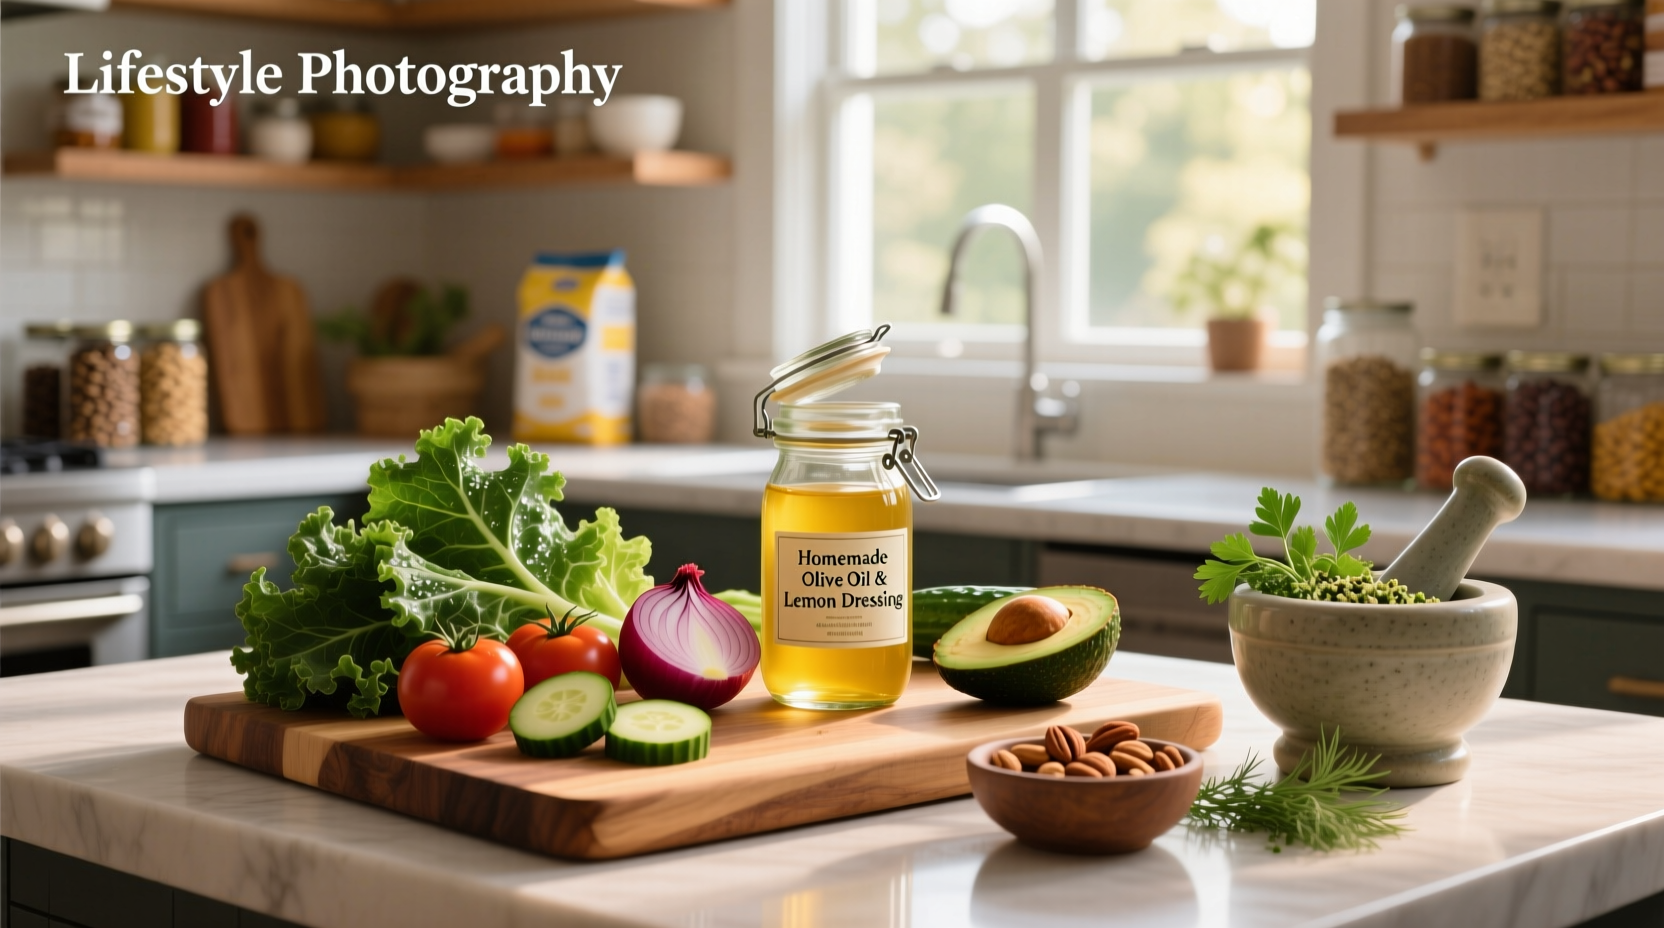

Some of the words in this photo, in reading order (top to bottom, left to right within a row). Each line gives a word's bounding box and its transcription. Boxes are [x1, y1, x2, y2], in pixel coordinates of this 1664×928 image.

[798, 548, 888, 566] Homemade
[801, 571, 843, 588] Olive
[847, 571, 870, 587] Oil
[874, 570, 887, 586] &
[784, 591, 836, 608] Lemon
[841, 590, 903, 610] Dressing
